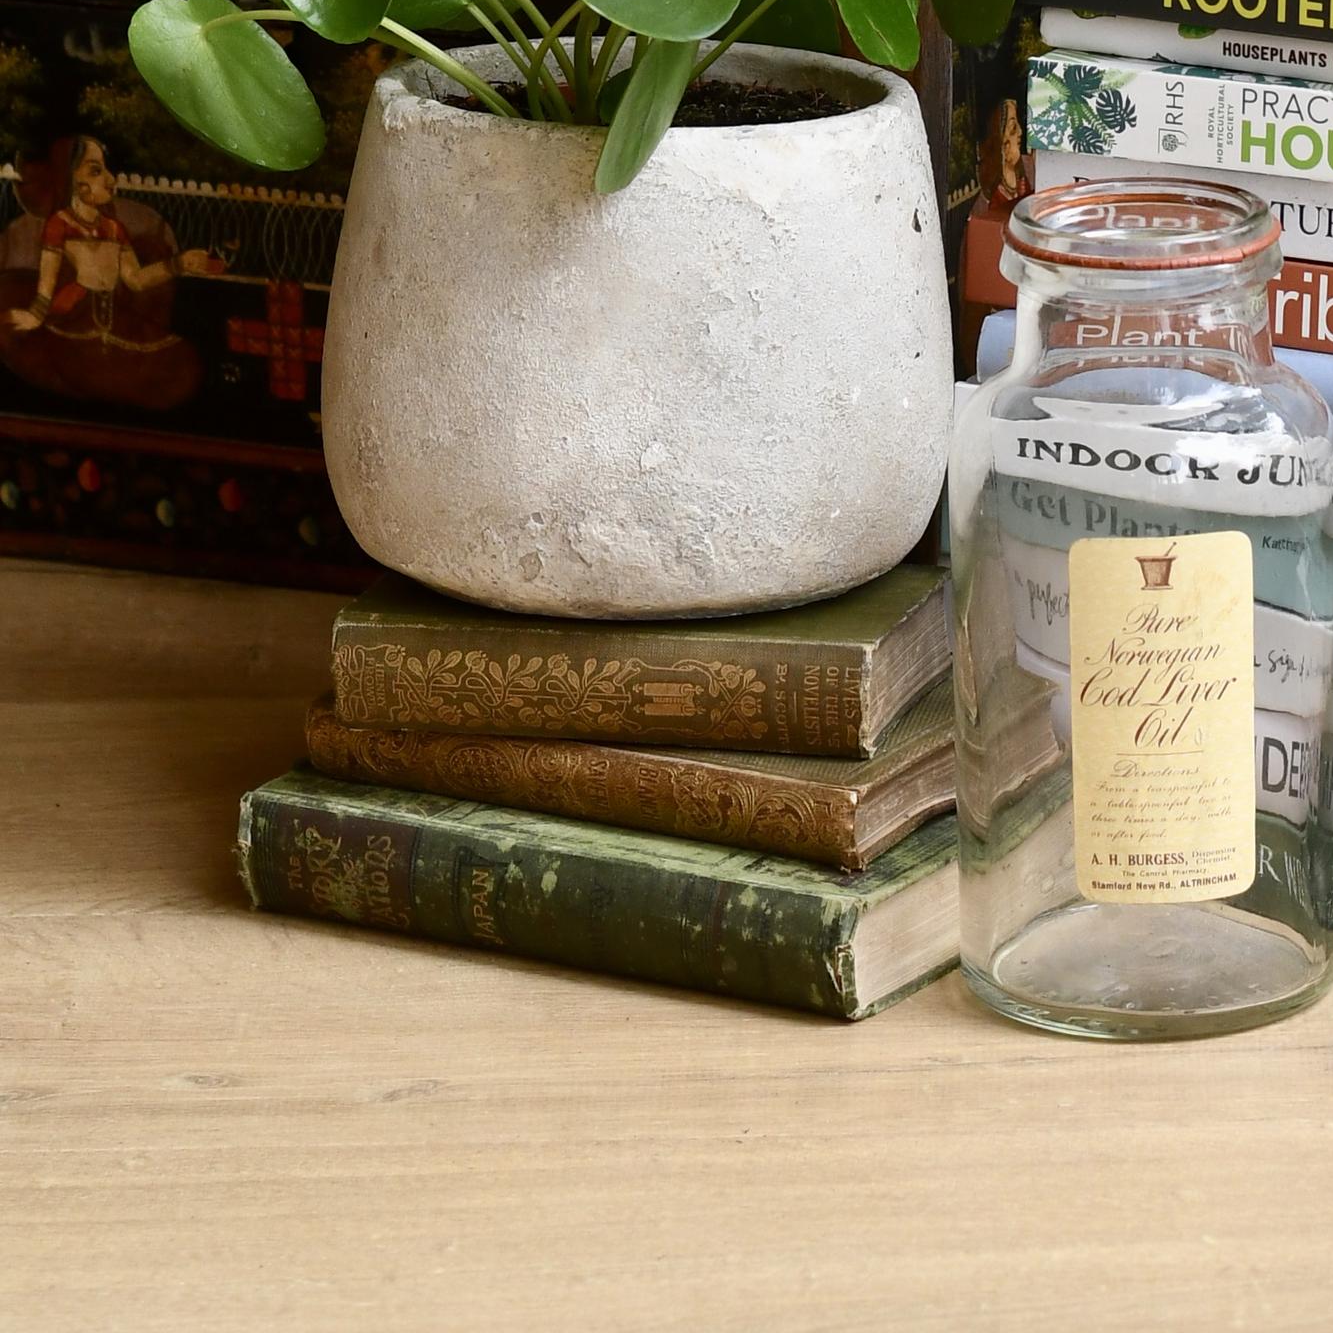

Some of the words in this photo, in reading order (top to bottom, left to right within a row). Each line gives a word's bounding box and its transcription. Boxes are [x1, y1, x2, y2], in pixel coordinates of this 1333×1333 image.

[1222, 41, 1328, 70] HOUSEPLANTS
[1165, 80, 1185, 126] RHS
[1207, 106, 1216, 138] ROYAL
[1216, 84, 1226, 164] HORTICULTURAL
[1226, 103, 1235, 146] SOCIETY
[1076, 311, 1204, 348] Plant
[1121, 603, 1199, 635] Pure
[826, 666, 840, 688] OF
[1083, 636, 1225, 685] Norwegian
[375, 663, 386, 707] HENRY
[803, 665, 821, 746] NOVELISTS
[842, 666, 861, 720] LIVES
[1079, 666, 1141, 708] Cod
[1141, 664, 1238, 708] Liver
[775, 690, 789, 744] SCOTT
[826, 693, 840, 727] THE
[1133, 705, 1195, 750] Oil
[1091, 853, 1103, 866] A.
[1108, 854, 1122, 867] H.
[1128, 852, 1189, 867] BURGESS,
[1122, 869, 1136, 878] The
[1139, 869, 1168, 878] Central
[1091, 880, 1132, 890] Stamford
[1136, 880, 1156, 891] New
